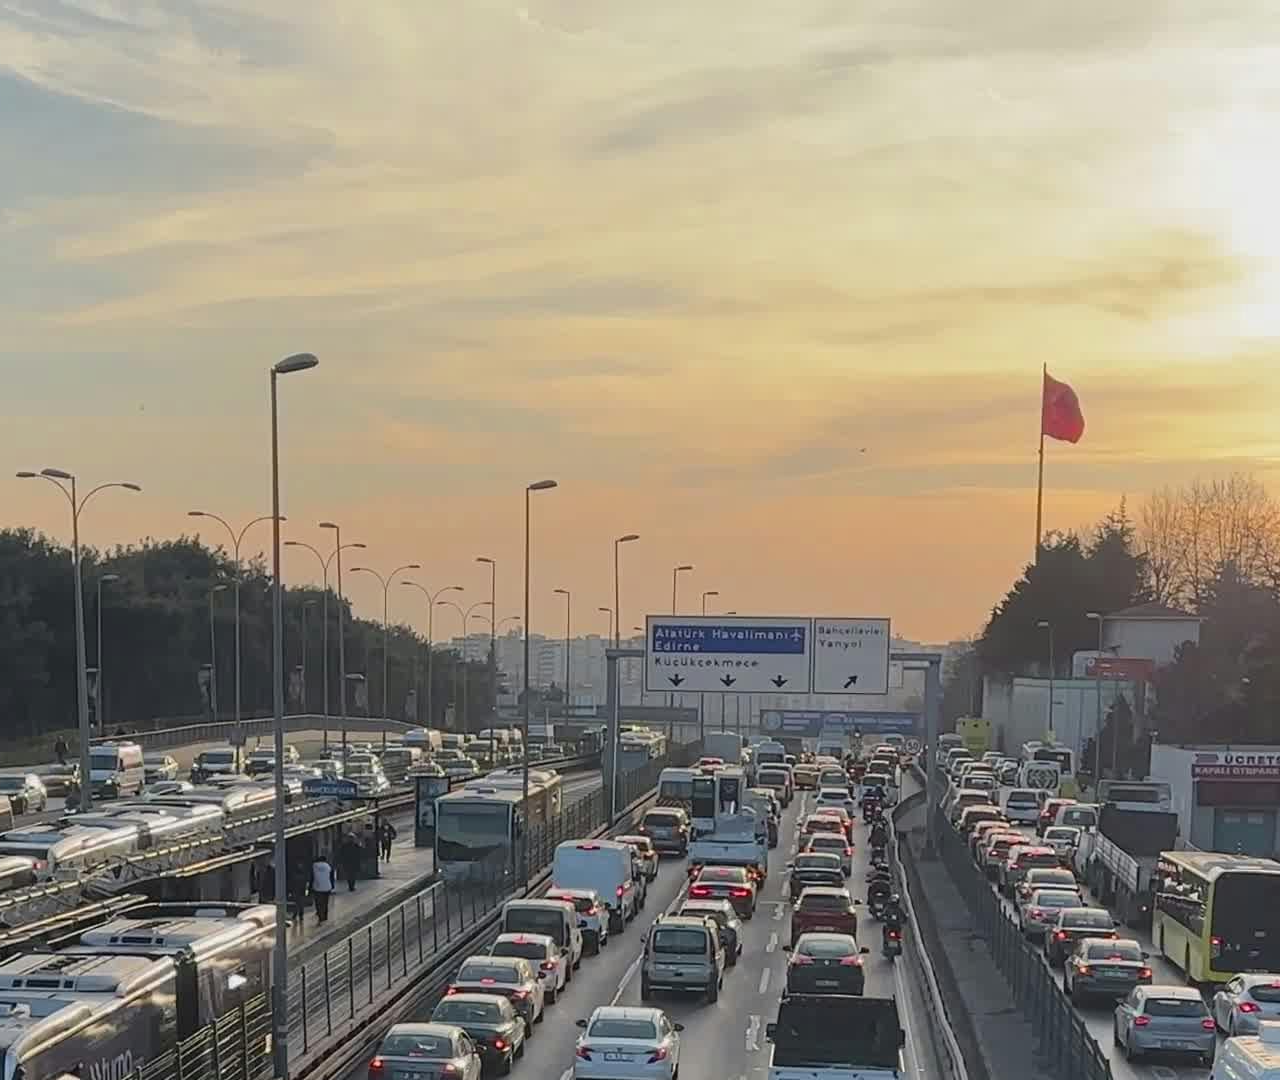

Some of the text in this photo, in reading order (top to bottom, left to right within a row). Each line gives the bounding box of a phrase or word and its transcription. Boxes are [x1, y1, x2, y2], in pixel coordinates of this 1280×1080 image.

[655, 625, 788, 641] Atatürk Havalimanı
[655, 641, 700, 652] Edirne
